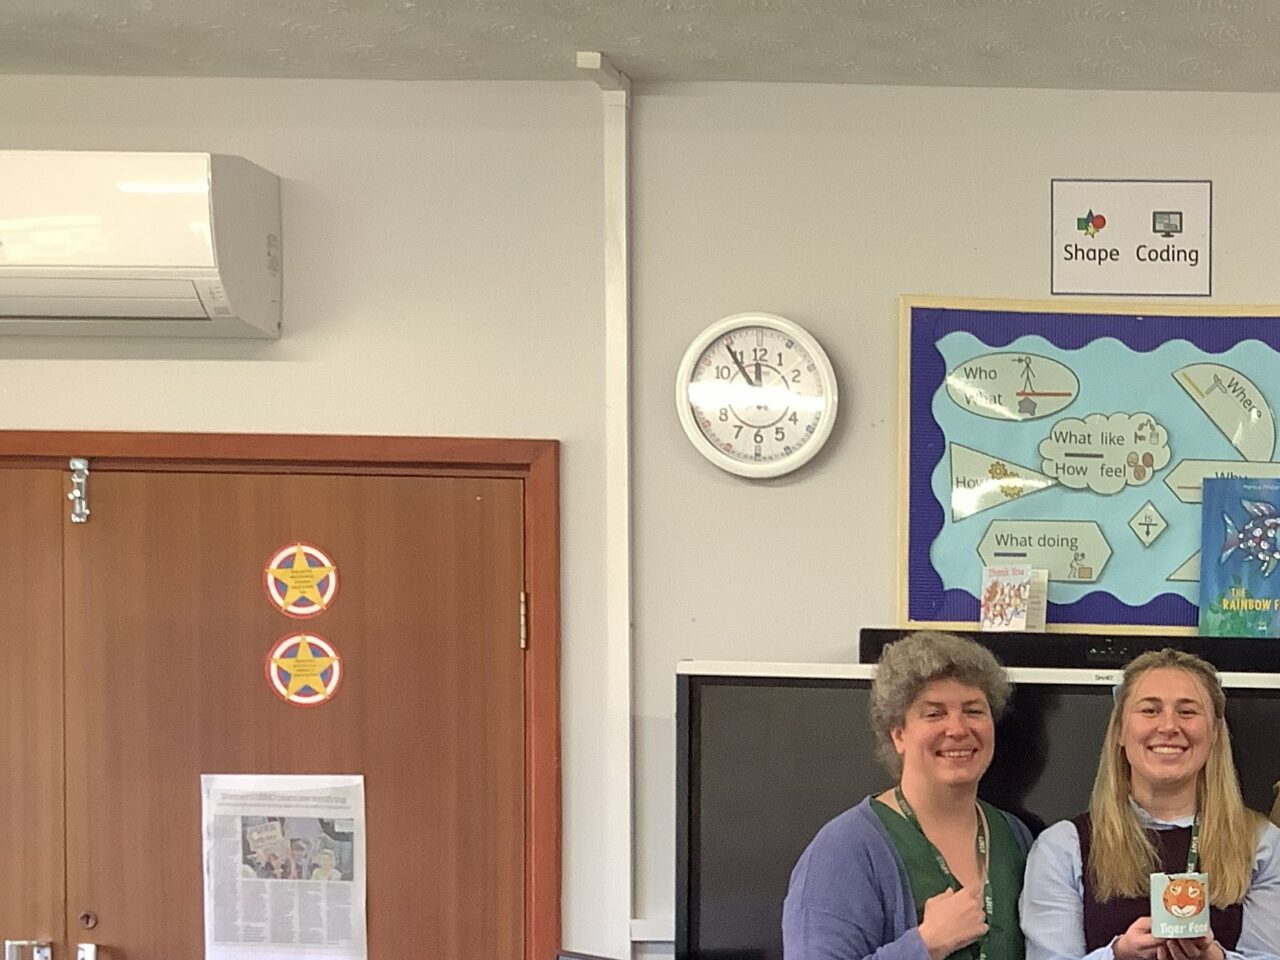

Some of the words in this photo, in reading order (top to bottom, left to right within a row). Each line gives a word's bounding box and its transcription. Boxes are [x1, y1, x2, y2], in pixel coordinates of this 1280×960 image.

[1064, 244, 1120, 266] Shape
[1136, 244, 1199, 267] Coding
[752, 348, 768, 362] 12
[777, 352, 784, 366] 1
[714, 366, 731, 380] 10
[791, 369, 801, 383] 2
[963, 367, 998, 380] Who
[718, 408, 729, 422] 8
[789, 411, 799, 426] 4
[733, 425, 743, 439] 7
[754, 430, 764, 444] 6
[775, 427, 785, 441] 5
[1054, 430, 1092, 445] What
[1100, 431, 1125, 446] like
[1055, 462, 1088, 477] How
[1101, 463, 1126, 477] feel
[1144, 514, 1153, 525] is
[995, 533, 1033, 548] What
[1037, 534, 1078, 551] doing
[1231, 588, 1246, 597] THE
[1222, 599, 1272, 611] RAINBOW
[1160, 922, 1187, 936] Tiger
